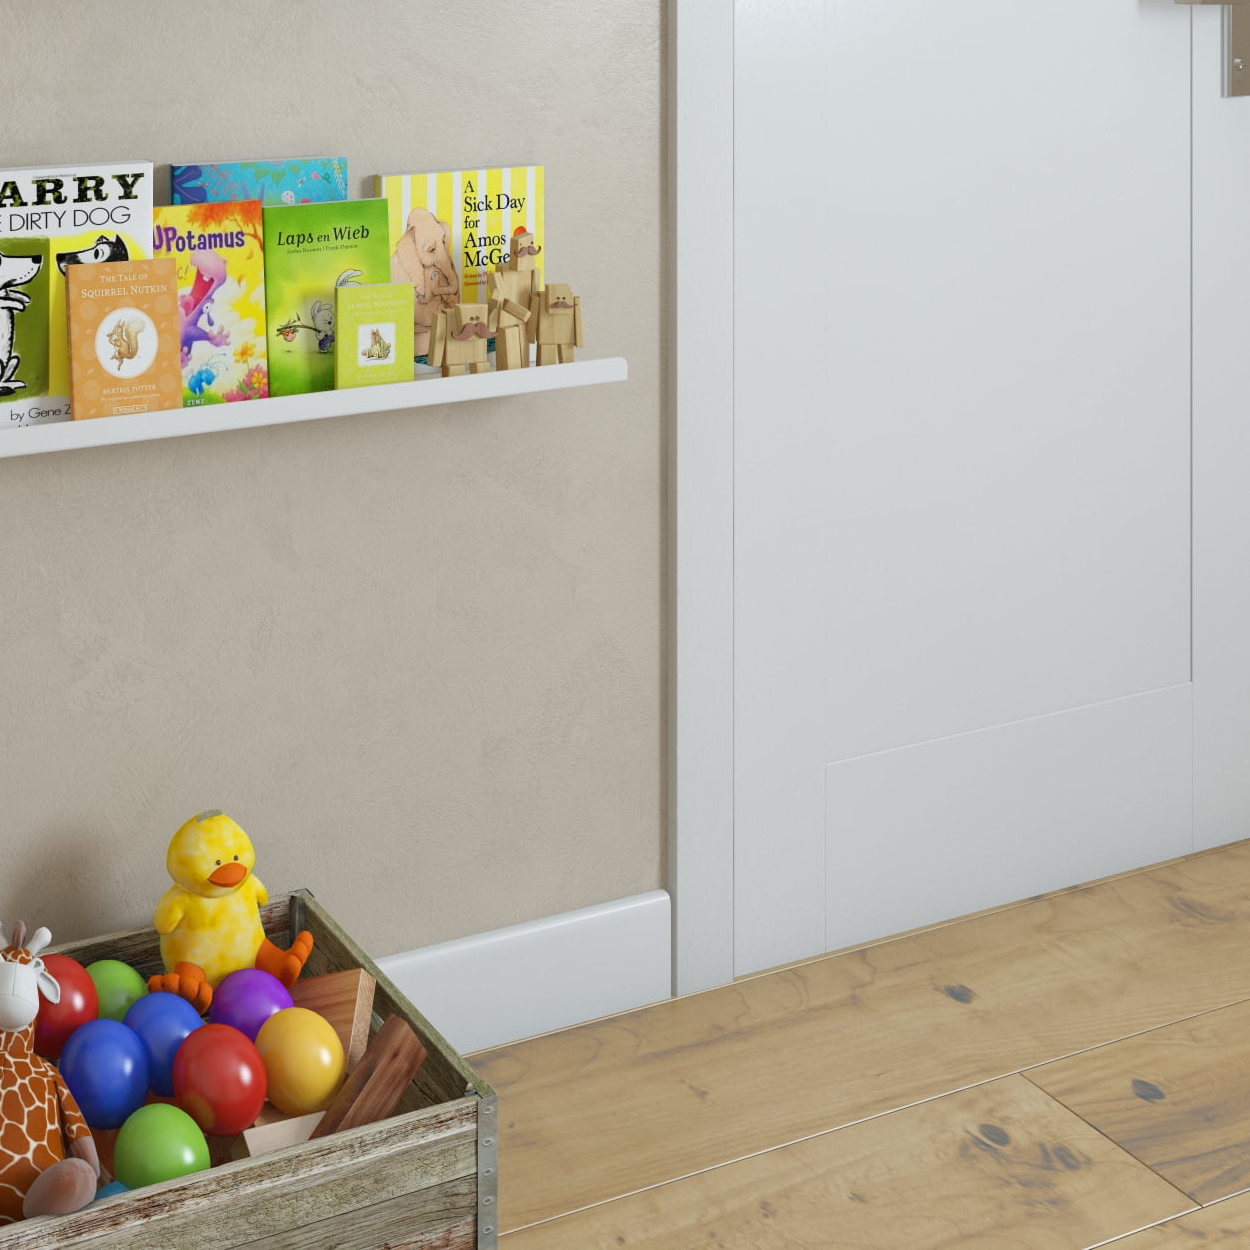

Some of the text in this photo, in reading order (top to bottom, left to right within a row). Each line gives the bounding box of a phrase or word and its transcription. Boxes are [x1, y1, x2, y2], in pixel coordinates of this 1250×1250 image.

[464, 180, 474, 193] A
[464, 193, 525, 212] Sick Day
[9, 210, 67, 232] DIRTY
[73, 205, 131, 227] DOG
[464, 216, 481, 229] for
[153, 224, 245, 252] UPotamus
[277, 231, 314, 248] Laps
[332, 225, 370, 241] Wieb
[464, 232, 507, 248] Amos
[464, 249, 510, 268] McGe
[99, 272, 149, 283] THE TALE OF
[177, 265, 190, 280] C!
[81, 284, 167, 299] SQUIRREL NUTKIN
[10, 409, 25, 422] by
[28, 407, 62, 418] Gene
